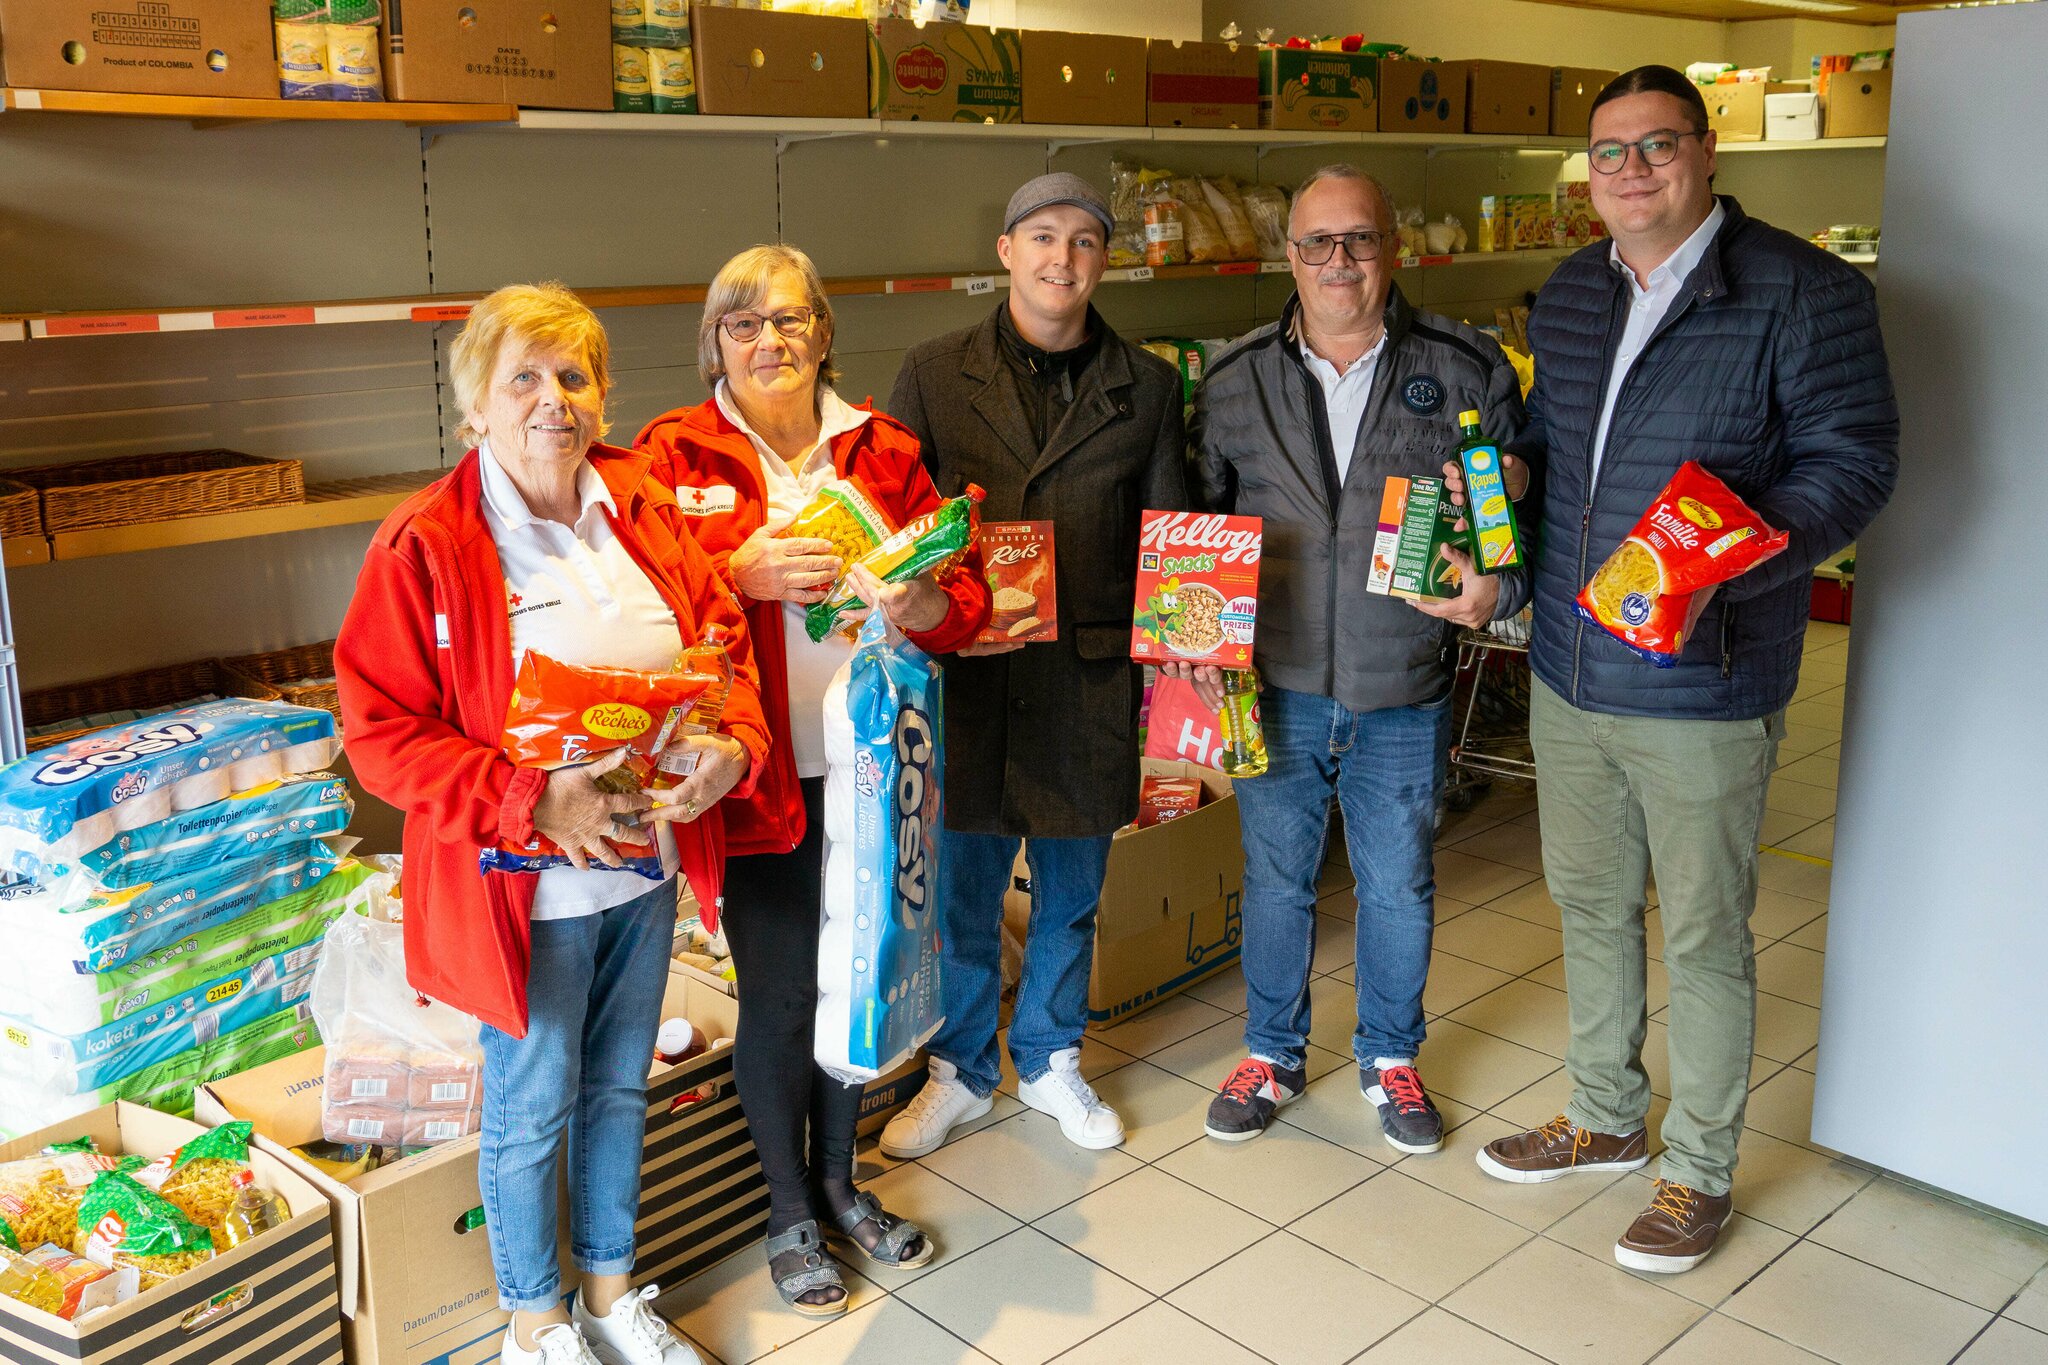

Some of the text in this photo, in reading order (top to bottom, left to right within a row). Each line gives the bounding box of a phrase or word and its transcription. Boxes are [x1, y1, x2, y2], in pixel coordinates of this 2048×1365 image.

[103, 57, 194, 69] Product of COLOMBIA
[973, 88, 1020, 103] Premium
[843, 484, 864, 506] PASTA
[1469, 471, 1500, 491] Rapso
[1650, 503, 1699, 551] Familie
[985, 541, 1041, 570] Reis
[1231, 601, 1255, 615] WIN
[1223, 620, 1253, 630] PRIZES
[589, 706, 647, 731] Recheis
[30, 722, 204, 786] Cosy
[159, 759, 185, 775] Unser
[855, 749, 873, 797] Cosy
[111, 774, 147, 804] Cosy
[177, 808, 243, 834] Toilettenpapier
[895, 702, 933, 912] Cosy
[857, 802, 869, 851] Liebstes
[867, 814, 877, 848] Unser
[234, 935, 290, 964] Toilettenpapier
[1112, 988, 1157, 1018] IKEA
[85, 1022, 138, 1056] kokett
[403, 1285, 494, 1334] Datum/Date/Date:
